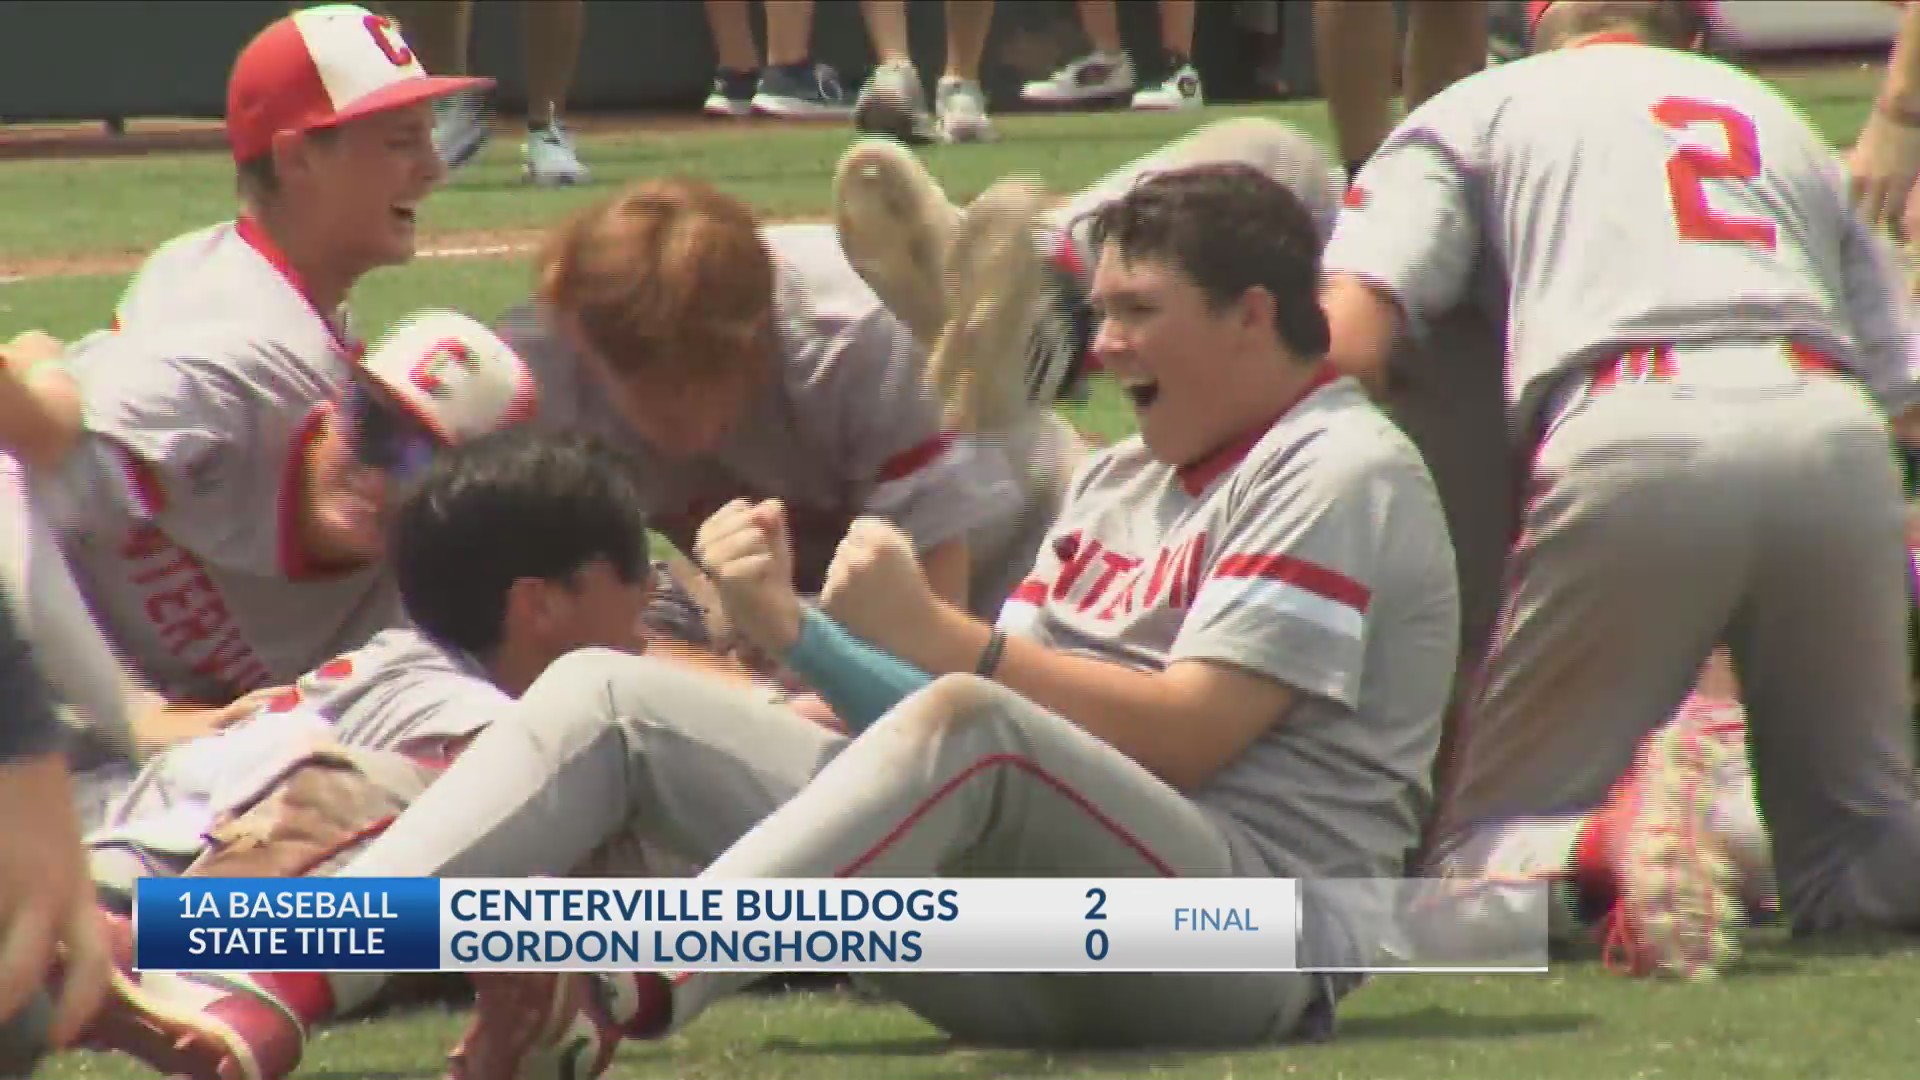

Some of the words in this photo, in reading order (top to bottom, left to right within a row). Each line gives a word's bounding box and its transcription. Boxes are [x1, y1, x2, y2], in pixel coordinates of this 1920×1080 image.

[363, 14, 412, 66] C
[1651, 97, 1777, 250] 2
[408, 336, 480, 398] C
